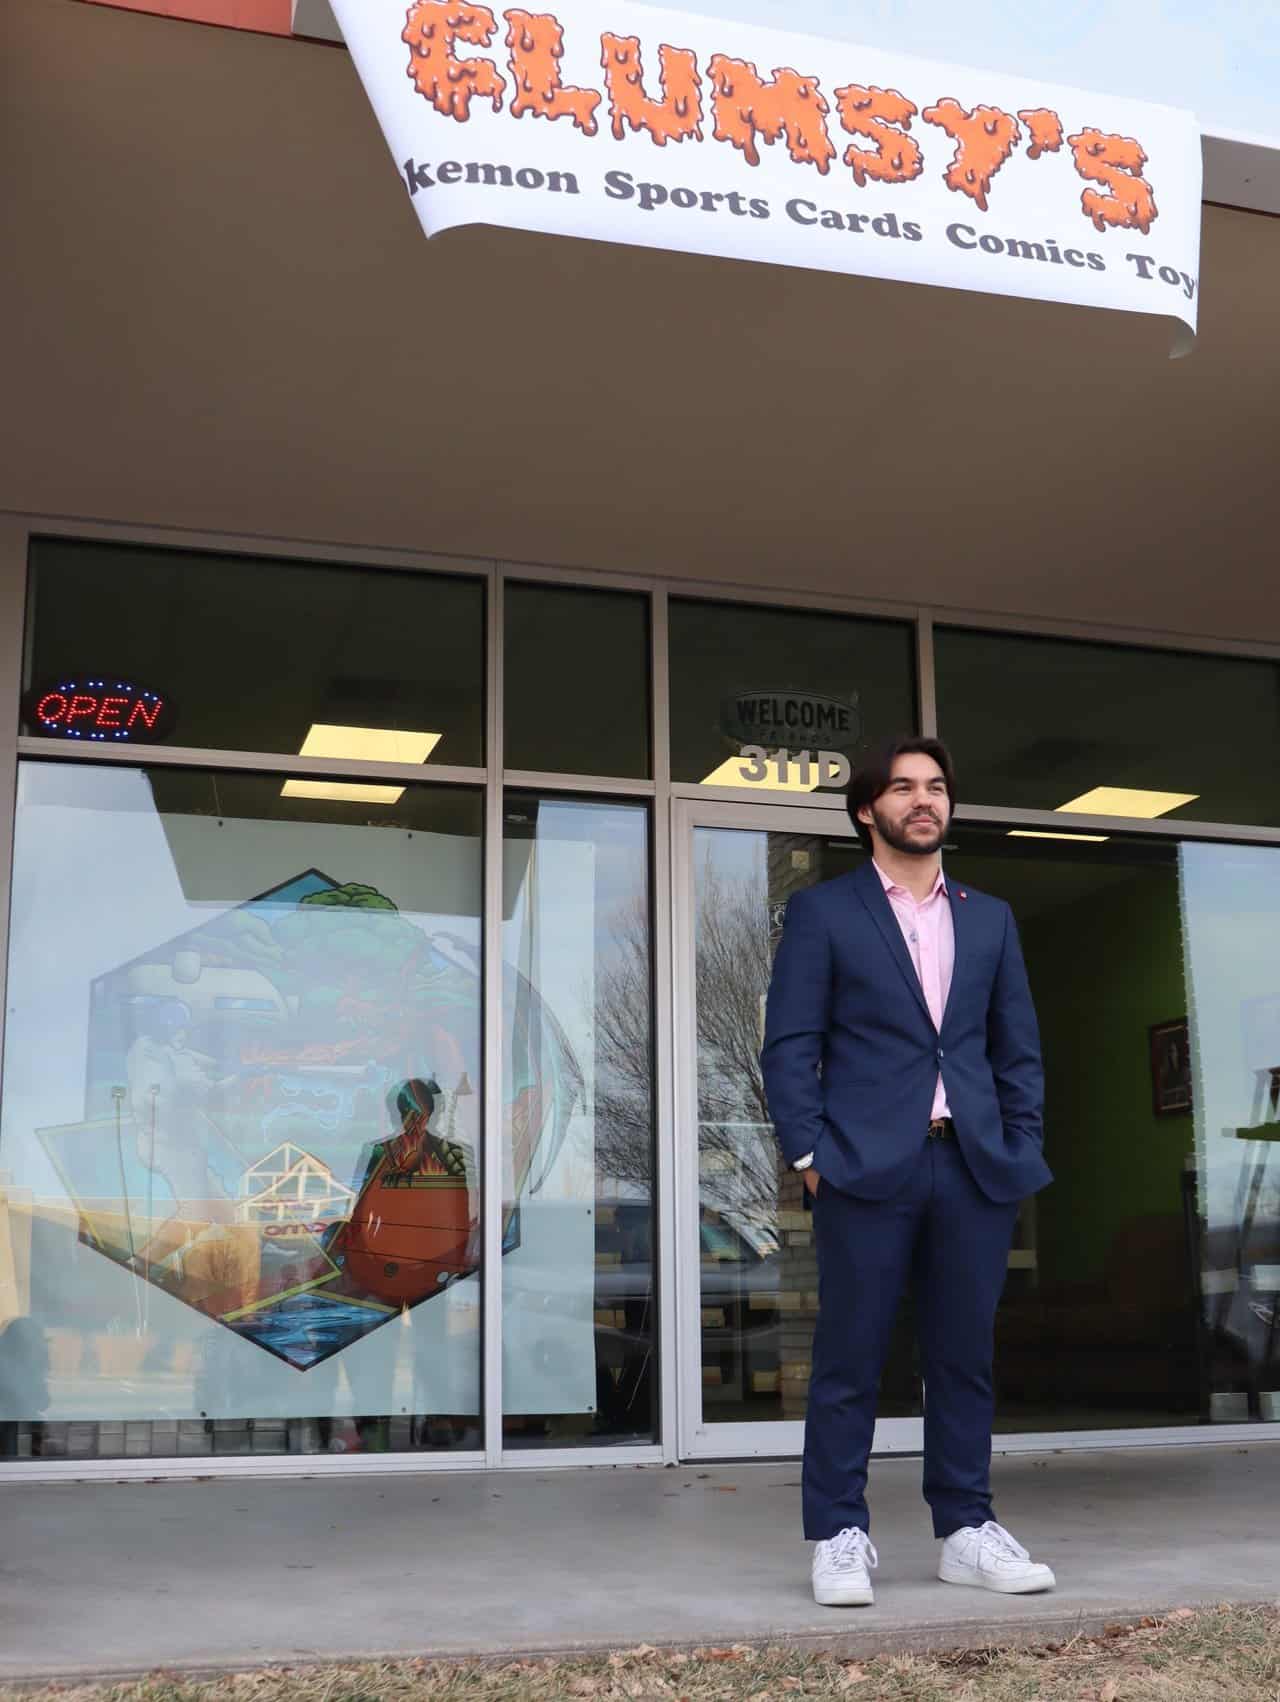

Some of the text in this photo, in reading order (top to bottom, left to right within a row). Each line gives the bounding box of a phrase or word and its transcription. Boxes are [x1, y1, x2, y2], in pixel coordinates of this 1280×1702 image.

[604, 170, 770, 219] Sports
[785, 198, 923, 241] Cards
[946, 223, 1106, 271] Comics
[1126, 253, 1199, 300] Toy
[36, 693, 163, 728] OPEN
[736, 698, 850, 732] WELCOME
[739, 744, 851, 788] 311D
